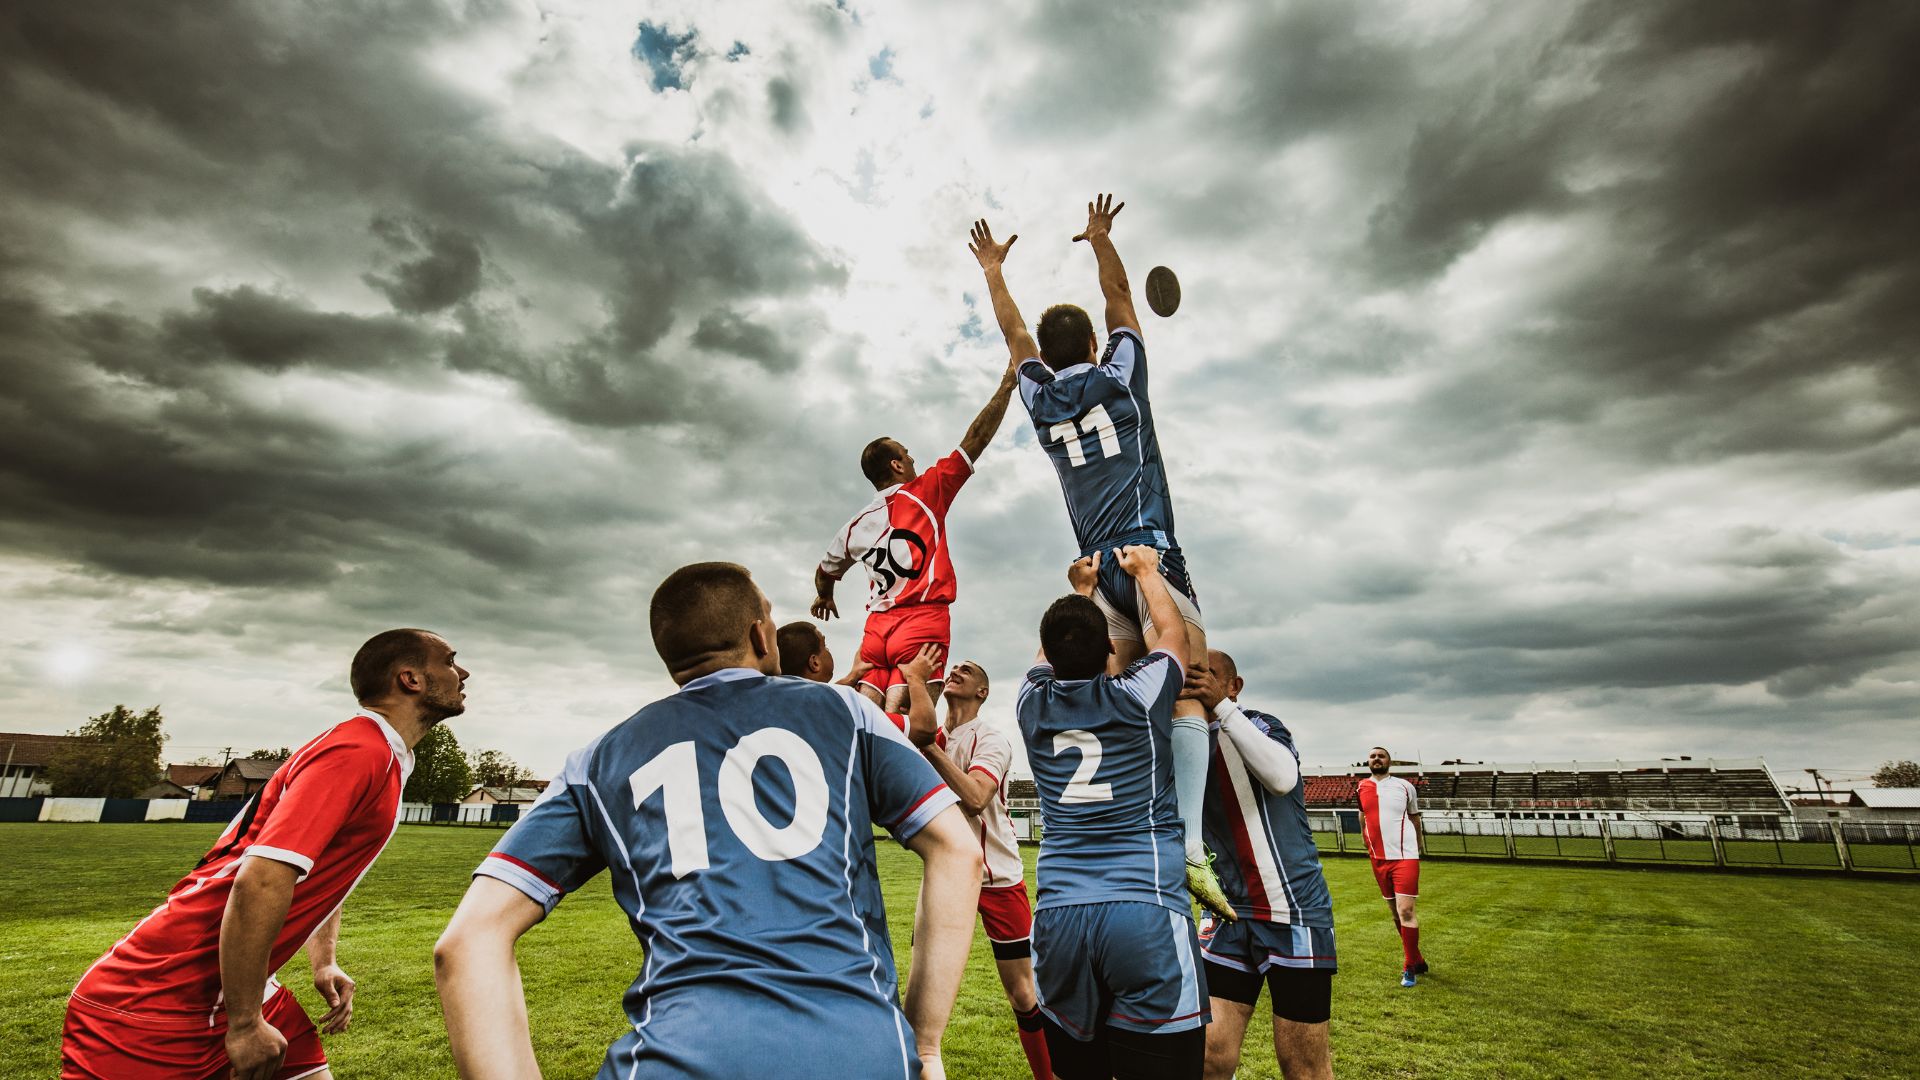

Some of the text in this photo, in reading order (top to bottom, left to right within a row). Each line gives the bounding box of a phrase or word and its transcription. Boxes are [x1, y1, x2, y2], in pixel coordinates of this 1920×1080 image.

[1049, 403, 1122, 467] 11
[861, 528, 927, 596] 30
[1052, 729, 1114, 804] 2
[628, 727, 830, 881] 10
